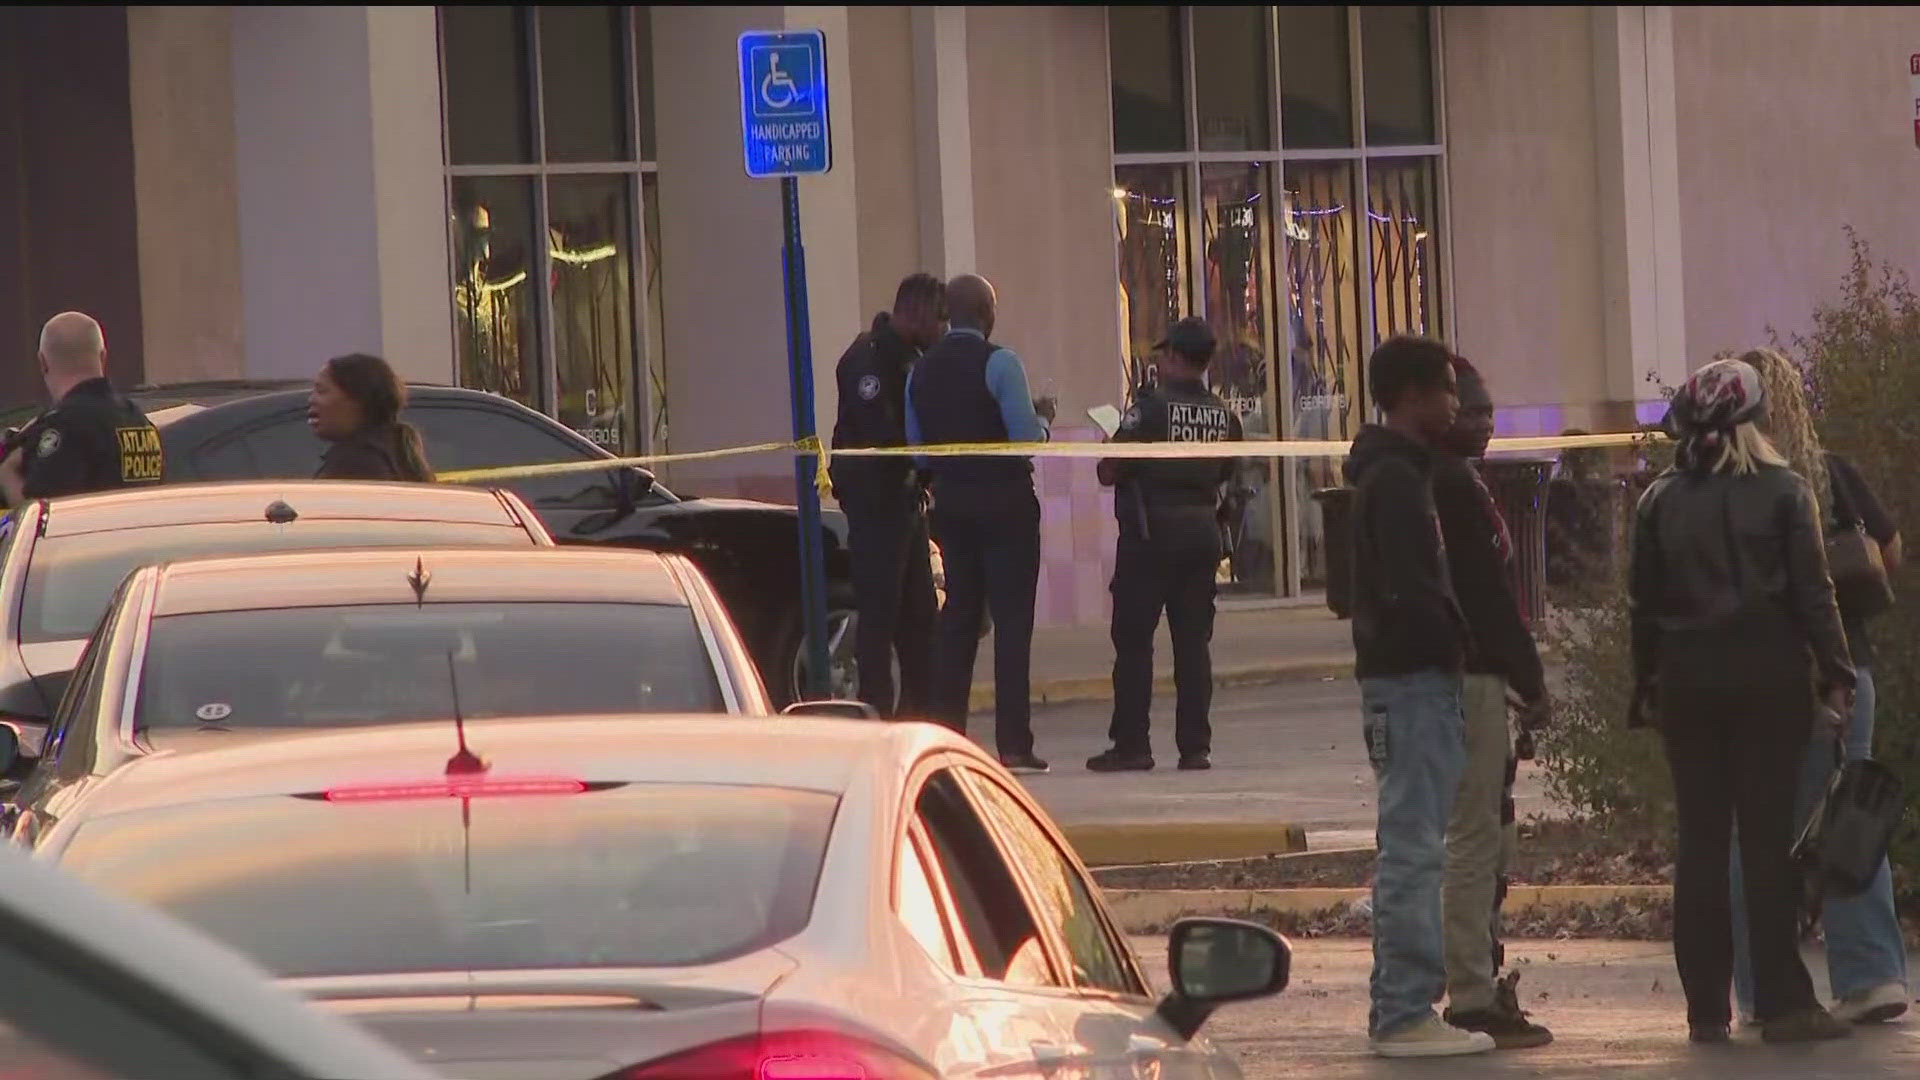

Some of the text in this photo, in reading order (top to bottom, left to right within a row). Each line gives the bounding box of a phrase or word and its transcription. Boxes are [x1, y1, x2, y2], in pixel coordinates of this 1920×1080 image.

[751, 122, 820, 140] HANDICAPPED
[764, 144, 810, 161] PARKING
[1171, 405, 1227, 429] ATLANTA
[1170, 425, 1226, 443] POLICE
[124, 455, 161, 477] POLICE
